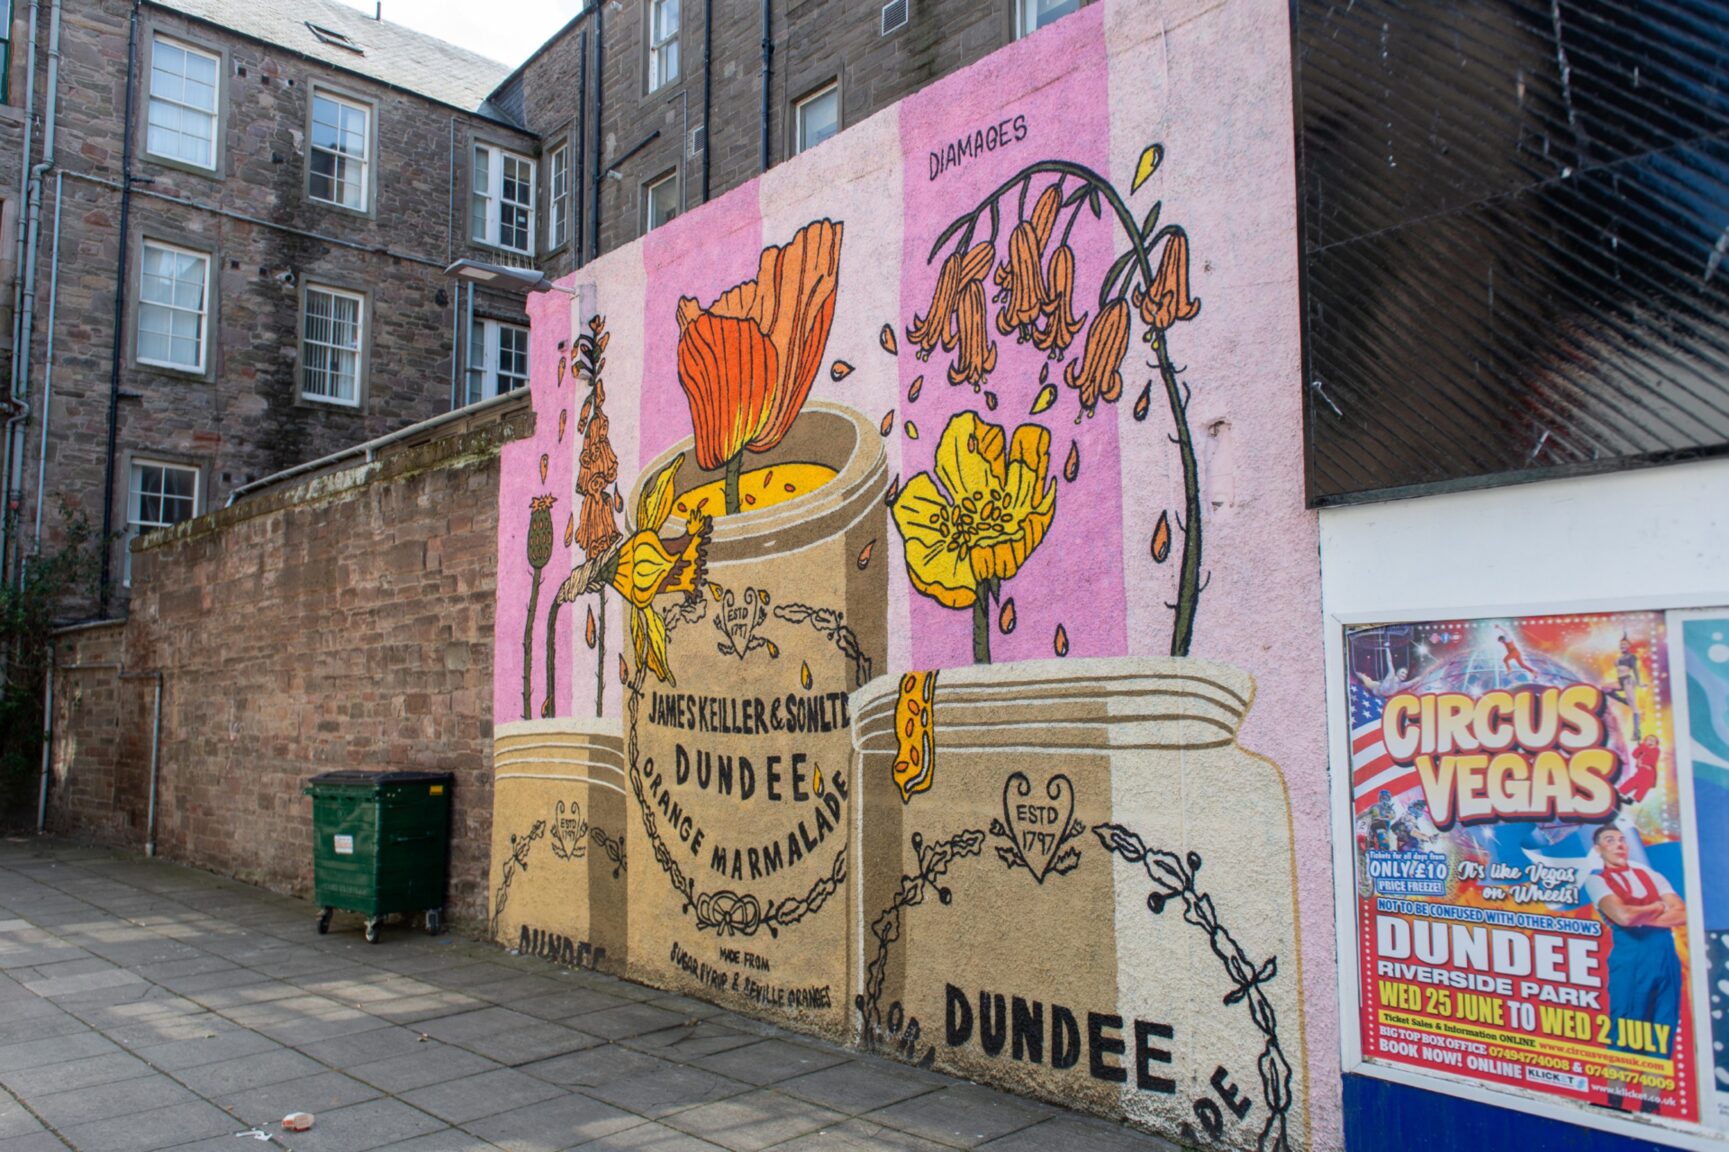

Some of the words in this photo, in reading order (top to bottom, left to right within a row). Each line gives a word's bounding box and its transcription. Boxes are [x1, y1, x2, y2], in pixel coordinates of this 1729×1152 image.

[929, 114, 1028, 181] DIAMAGES
[727, 607, 748, 622] ESTD
[648, 691, 697, 730] JAMES
[698, 695, 769, 735] KEILLER
[769, 697, 785, 731] &
[785, 693, 819, 733] SON
[818, 691, 851, 733] LTD
[1382, 684, 1601, 765] CIRCUS
[675, 743, 810, 802] DUNDEE
[1415, 749, 1618, 826] VEGAS
[560, 818, 577, 829] ESTD
[643, 756, 705, 857] ORANGE
[710, 770, 849, 881] MARMALADE
[1016, 804, 1059, 826] ESTD
[1022, 829, 1056, 856] 1797
[1369, 851, 1391, 860] Tickets
[1393, 852, 1402, 860] for
[1370, 859, 1411, 878] ONLY
[1415, 861, 1447, 880] £10
[1379, 880, 1406, 892] PRICE
[1458, 860, 1485, 881] It's
[1490, 862, 1522, 880] like
[1525, 862, 1576, 889] Vegas
[1377, 898, 1400, 912] NOT
[1400, 901, 1414, 914] TO
[1415, 902, 1429, 916] BE
[1429, 904, 1483, 923] CONFUSED
[1485, 909, 1516, 926] WITH
[1516, 914, 1555, 931] OTHER
[1556, 920, 1601, 936] SHOWS
[1482, 886, 1506, 900] on
[1509, 885, 1579, 904] Wheels!
[670, 941, 699, 979] SUGAR
[699, 962, 728, 990] SYRUP
[731, 971, 740, 992] &
[743, 976, 786, 1008] SEVILLE
[787, 984, 832, 1009] ORANGES
[719, 946, 741, 965] MADE
[743, 951, 771, 973] FROM
[1376, 915, 1601, 988] DUNDEE
[1377, 960, 1514, 996] RIVERSIDE
[1519, 981, 1602, 1010] PARK
[945, 982, 1177, 1095] DUNDEE
[1378, 980, 1422, 1012] WED
[1425, 987, 1452, 1017] 25
[1456, 992, 1505, 1026] JUNE
[1507, 1000, 1536, 1032] TO
[1539, 1005, 1592, 1041] WED
[1596, 1014, 1612, 1045] 2
[1617, 1018, 1671, 1054] JULY
[1379, 1025, 1400, 1037] BIG
[1400, 1028, 1422, 1040] TOP
[1422, 1032, 1446, 1045] BOX
[1446, 1036, 1488, 1055] OFFICE
[1488, 1045, 1570, 1071] 07494774008
[1572, 1061, 1583, 1074] &
[1584, 1062, 1676, 1092] 07494774009
[1379, 1038, 1419, 1058] BOOK
[1422, 1046, 1463, 1067] NOW!
[1466, 1055, 1523, 1080] ONLINE
[1384, 1013, 1410, 1026] Ticket
[1411, 1017, 1433, 1030] Sales
[1435, 1022, 1442, 1031] &
[1444, 1023, 1498, 1041] Information
[1499, 1034, 1537, 1048] ONLINE
[1539, 1042, 1666, 1071] www.circusvegasuk.com
